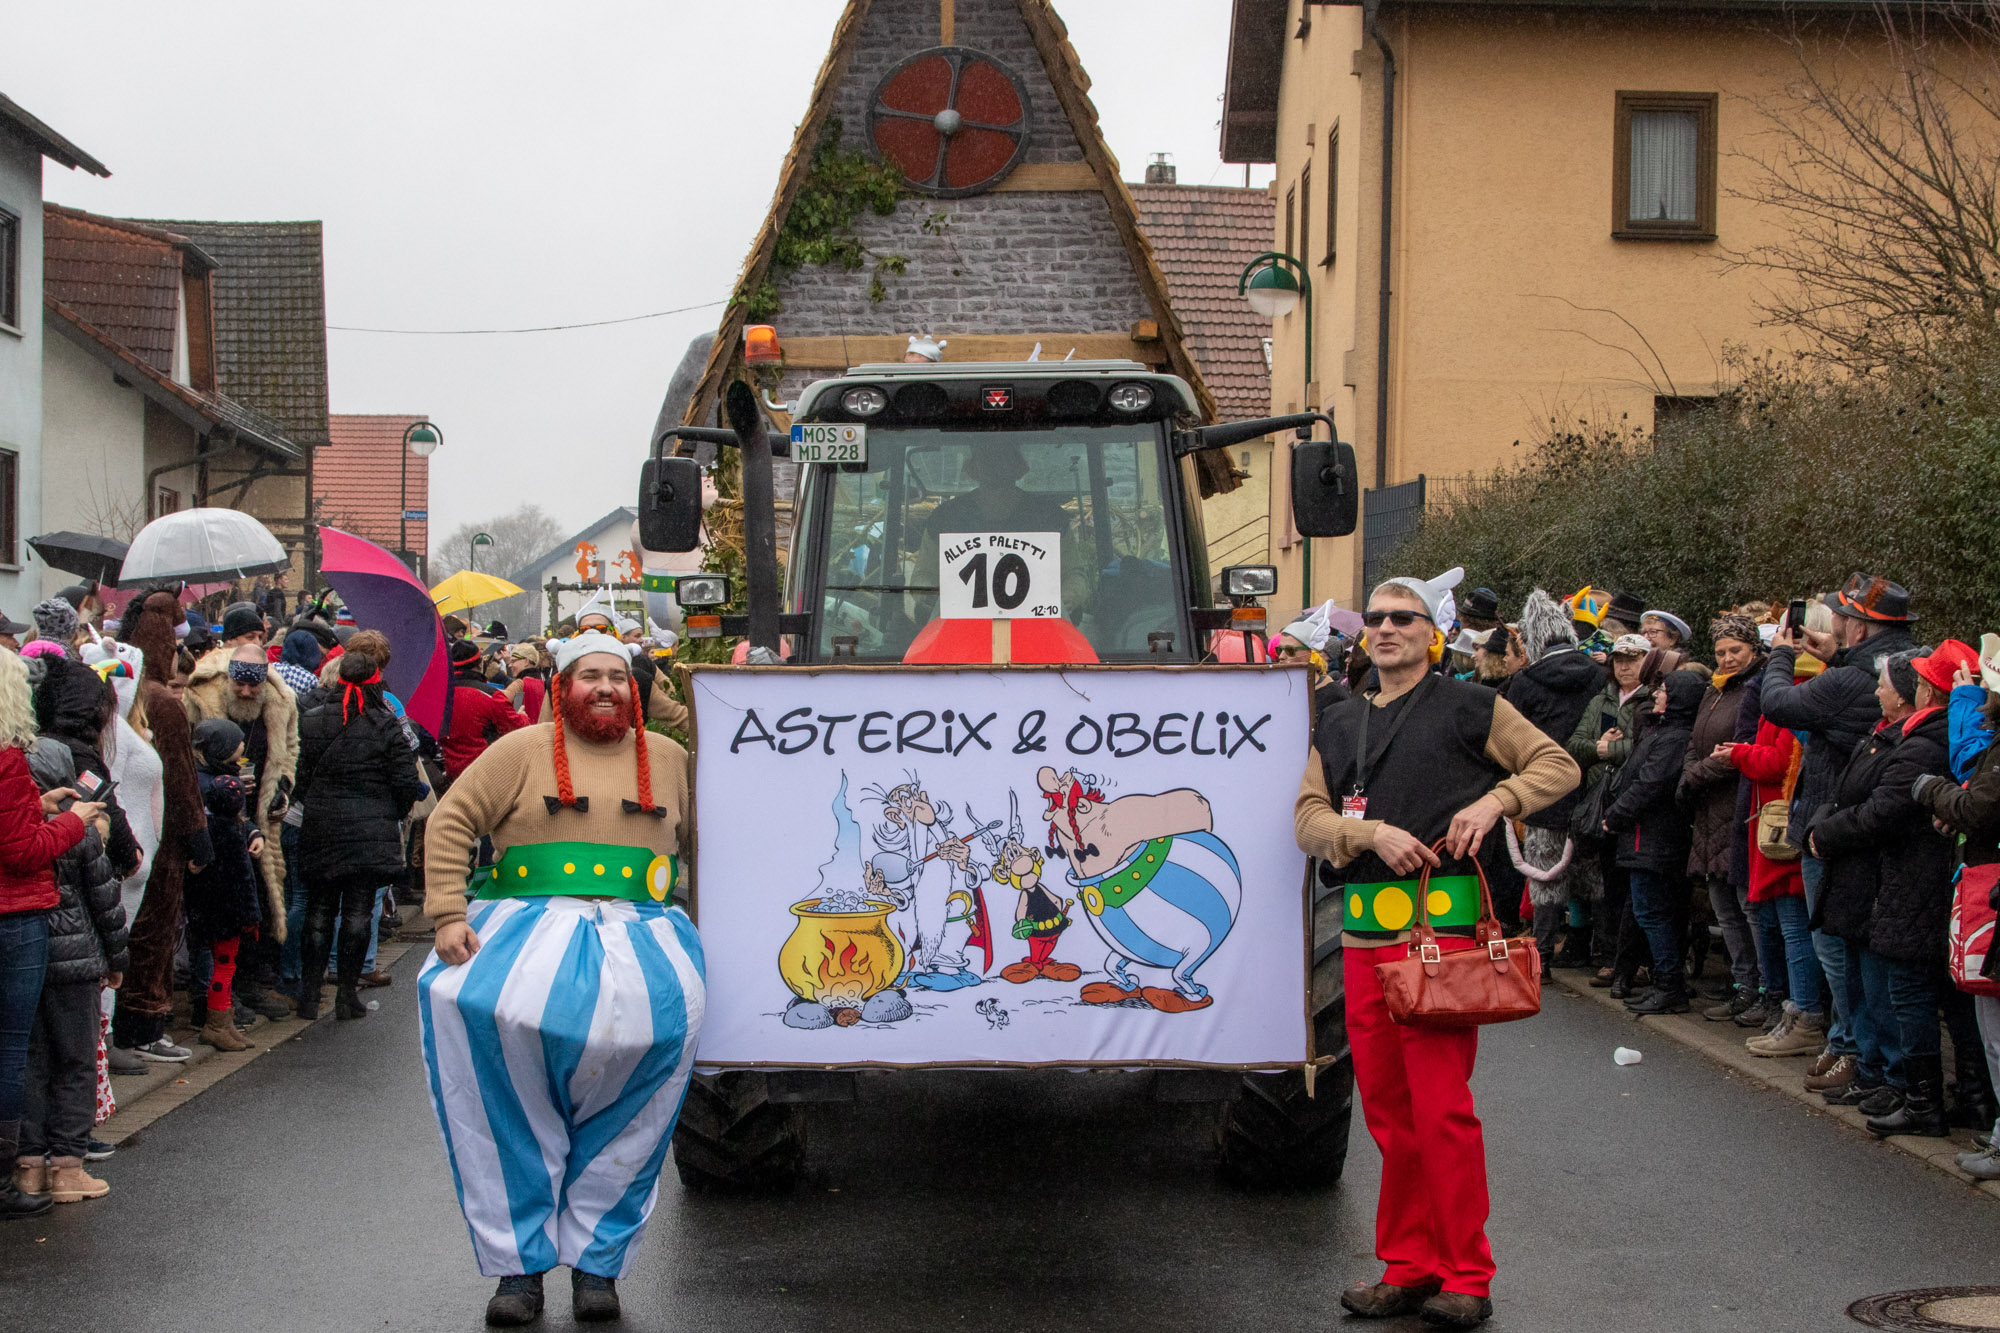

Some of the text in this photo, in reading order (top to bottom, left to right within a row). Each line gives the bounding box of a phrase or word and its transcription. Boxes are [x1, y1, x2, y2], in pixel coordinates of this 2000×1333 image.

[804, 427, 837, 443] MOS
[799, 445, 859, 460] MD 228
[944, 535, 1046, 563] ALLES PALETTI
[959, 553, 1030, 610] 10
[1031, 605, 1058, 616] 12:10
[1012, 710, 1046, 755] &
